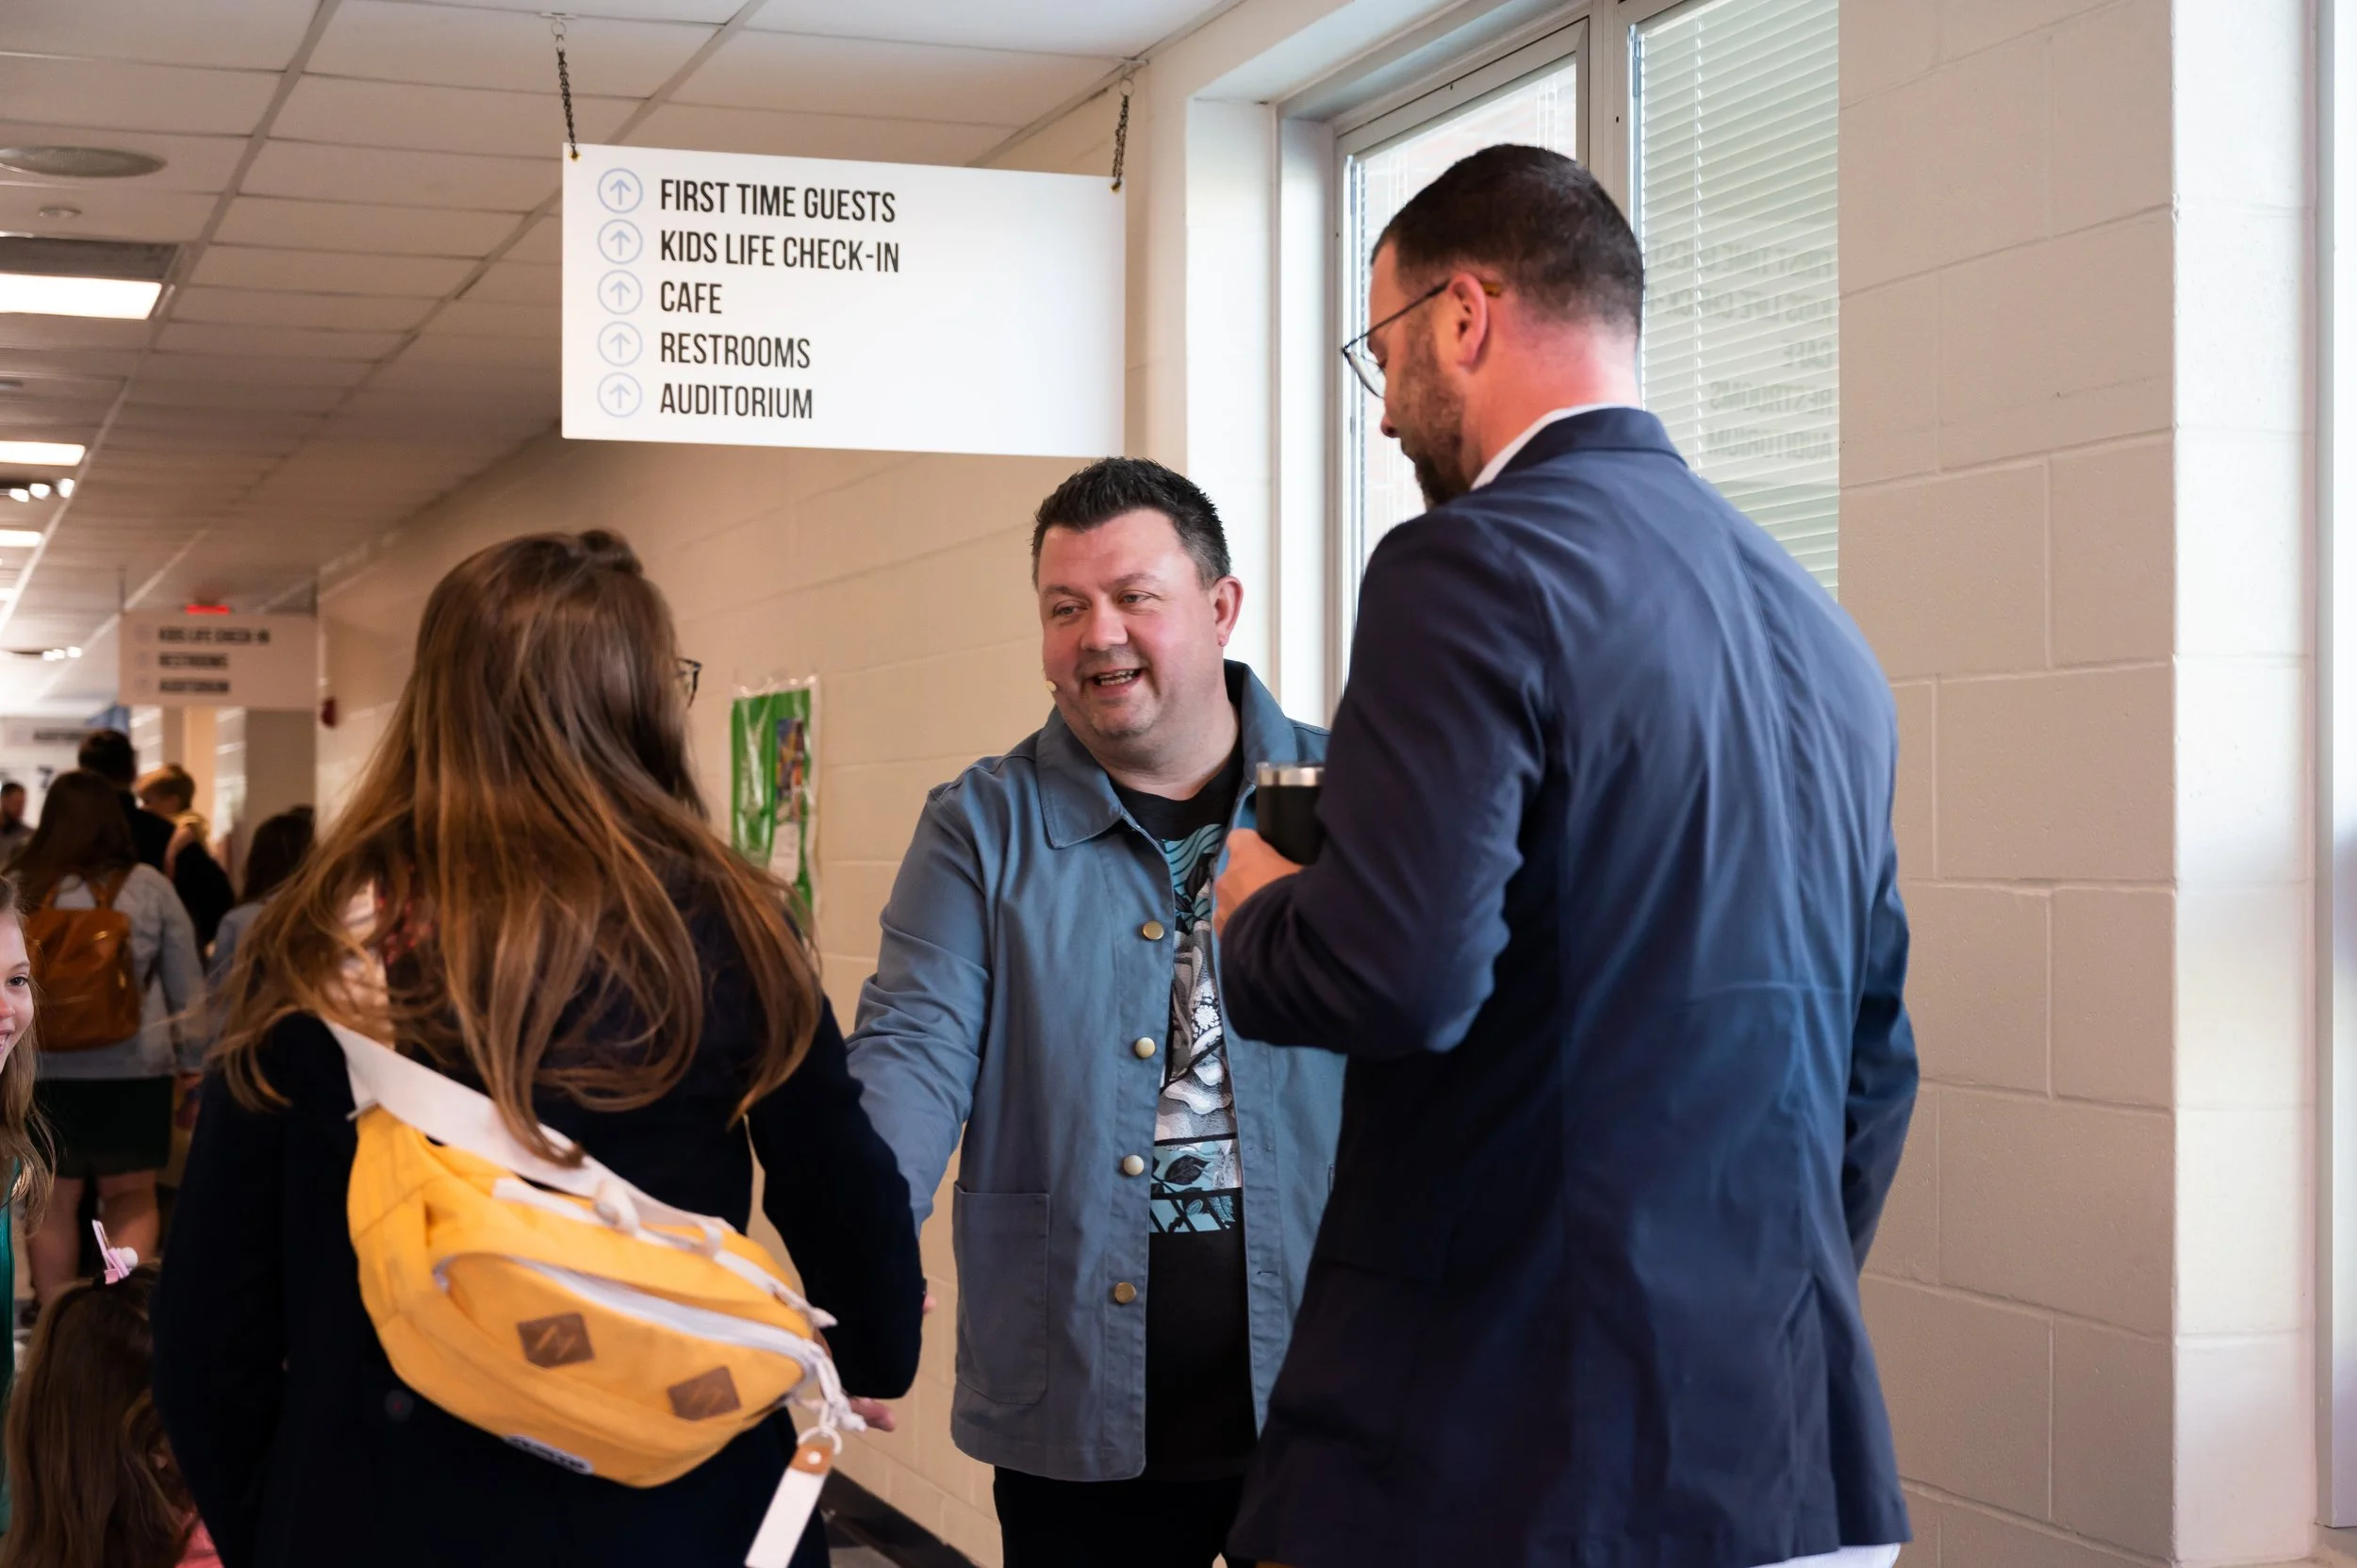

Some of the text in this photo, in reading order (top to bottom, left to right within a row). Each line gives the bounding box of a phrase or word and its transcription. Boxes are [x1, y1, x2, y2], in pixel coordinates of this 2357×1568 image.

[661, 178, 896, 223] FIRST TIME GUESTS
[661, 229, 899, 273] KIDS LIFE CHECK-IN
[660, 280, 722, 314] CAFE
[661, 332, 811, 369] RESTROOMS
[660, 383, 813, 420] AUDITORIUM
